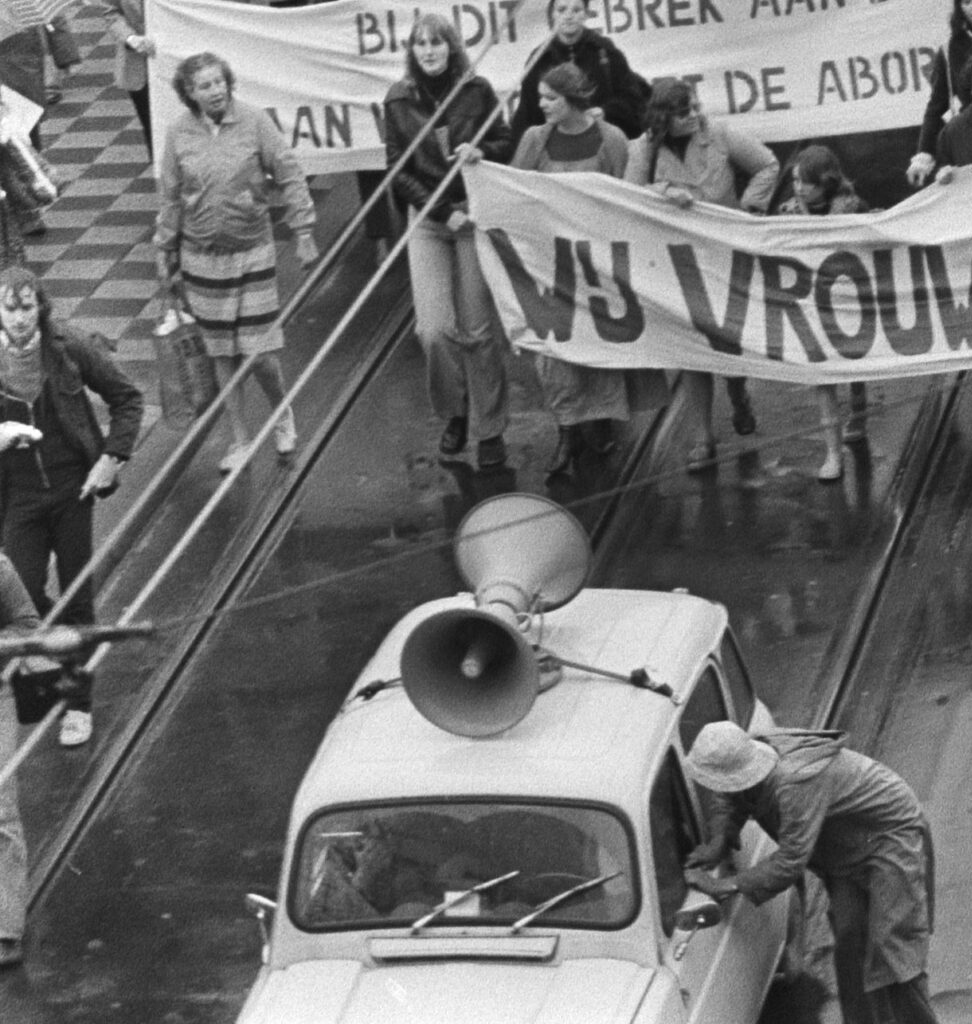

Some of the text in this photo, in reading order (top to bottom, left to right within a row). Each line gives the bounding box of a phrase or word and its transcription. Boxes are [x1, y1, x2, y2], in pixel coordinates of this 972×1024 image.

[452, 0, 523, 49] DIT
[724, 66, 791, 115] DE
[817, 46, 942, 106] ABOR
